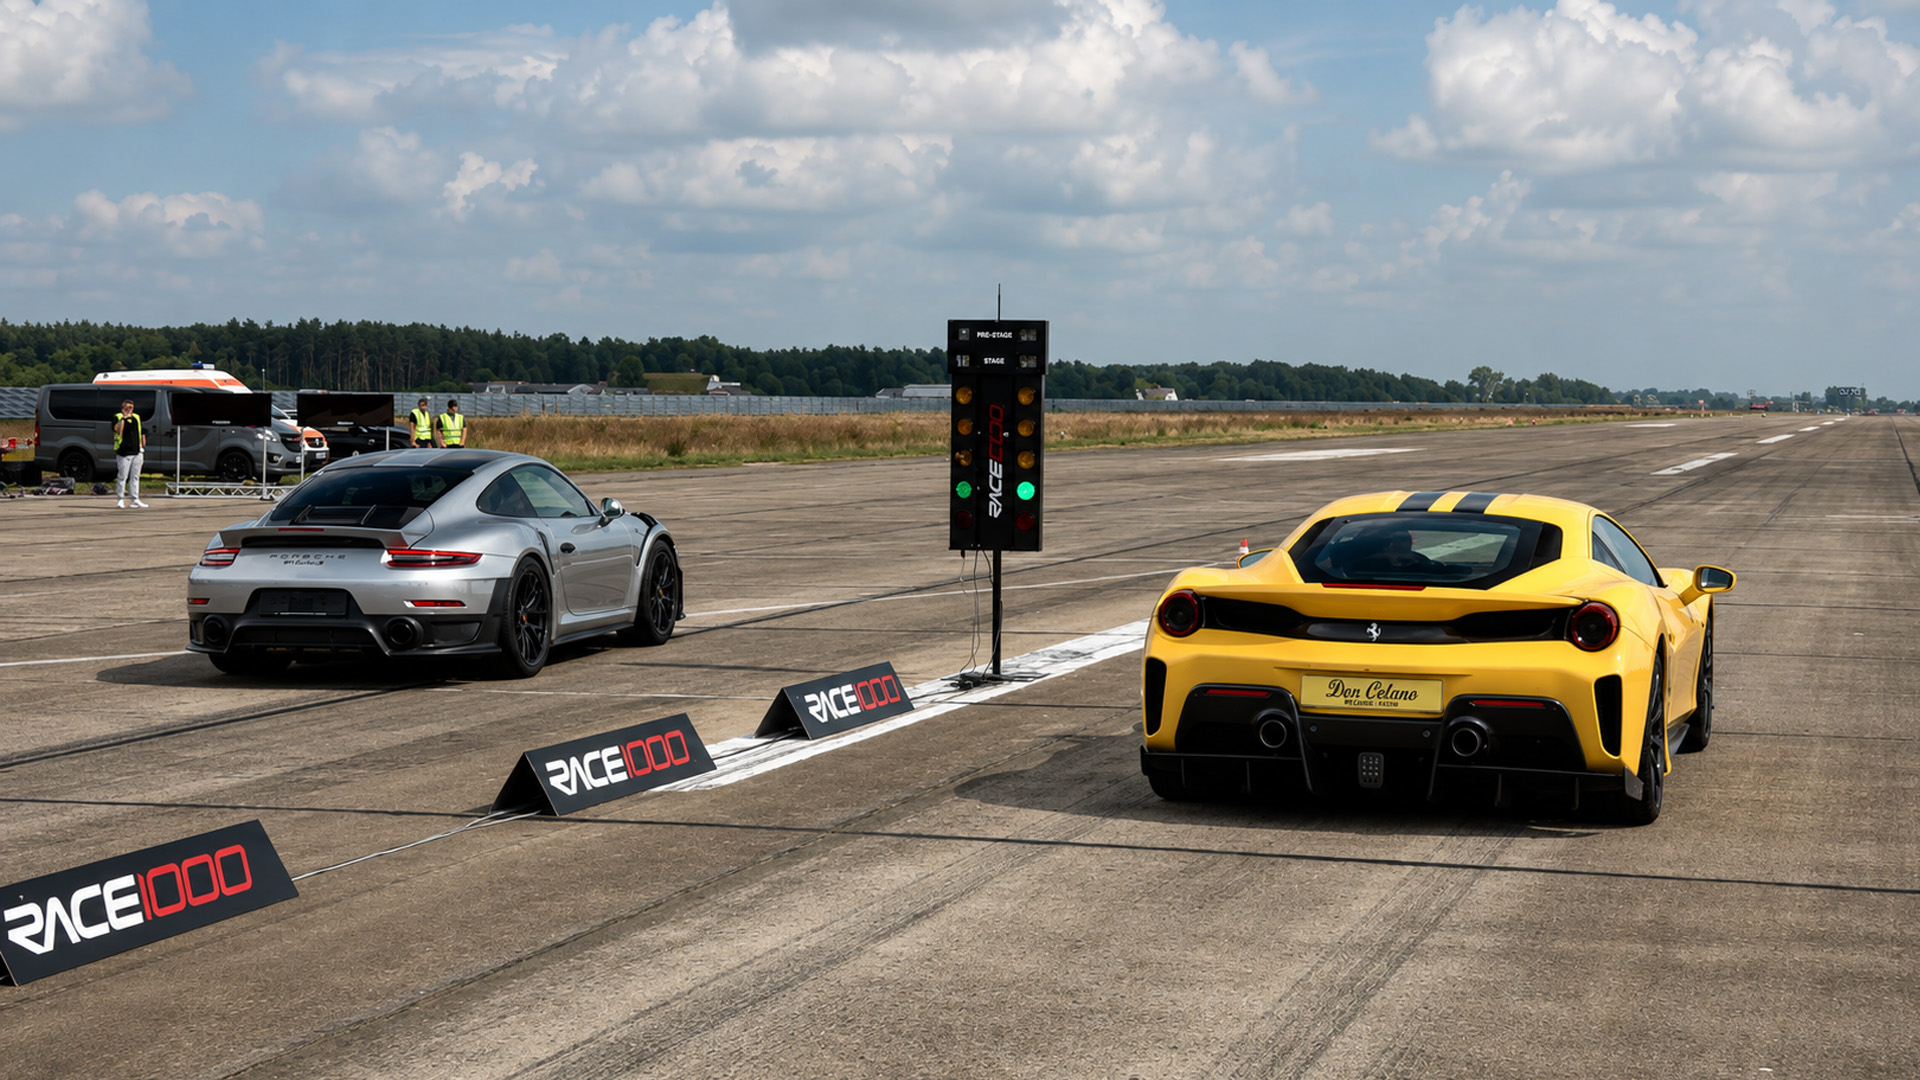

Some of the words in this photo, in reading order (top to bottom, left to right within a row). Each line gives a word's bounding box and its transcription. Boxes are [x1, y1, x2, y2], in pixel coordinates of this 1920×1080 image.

[977, 331, 1013, 339] PRE-STAGE
[983, 357, 1005, 365] STAGE
[804, 674, 902, 724] RACE1000
[1326, 679, 1361, 698] Don
[545, 730, 690, 796] RACE1000
[4, 844, 252, 955] RACE1000
